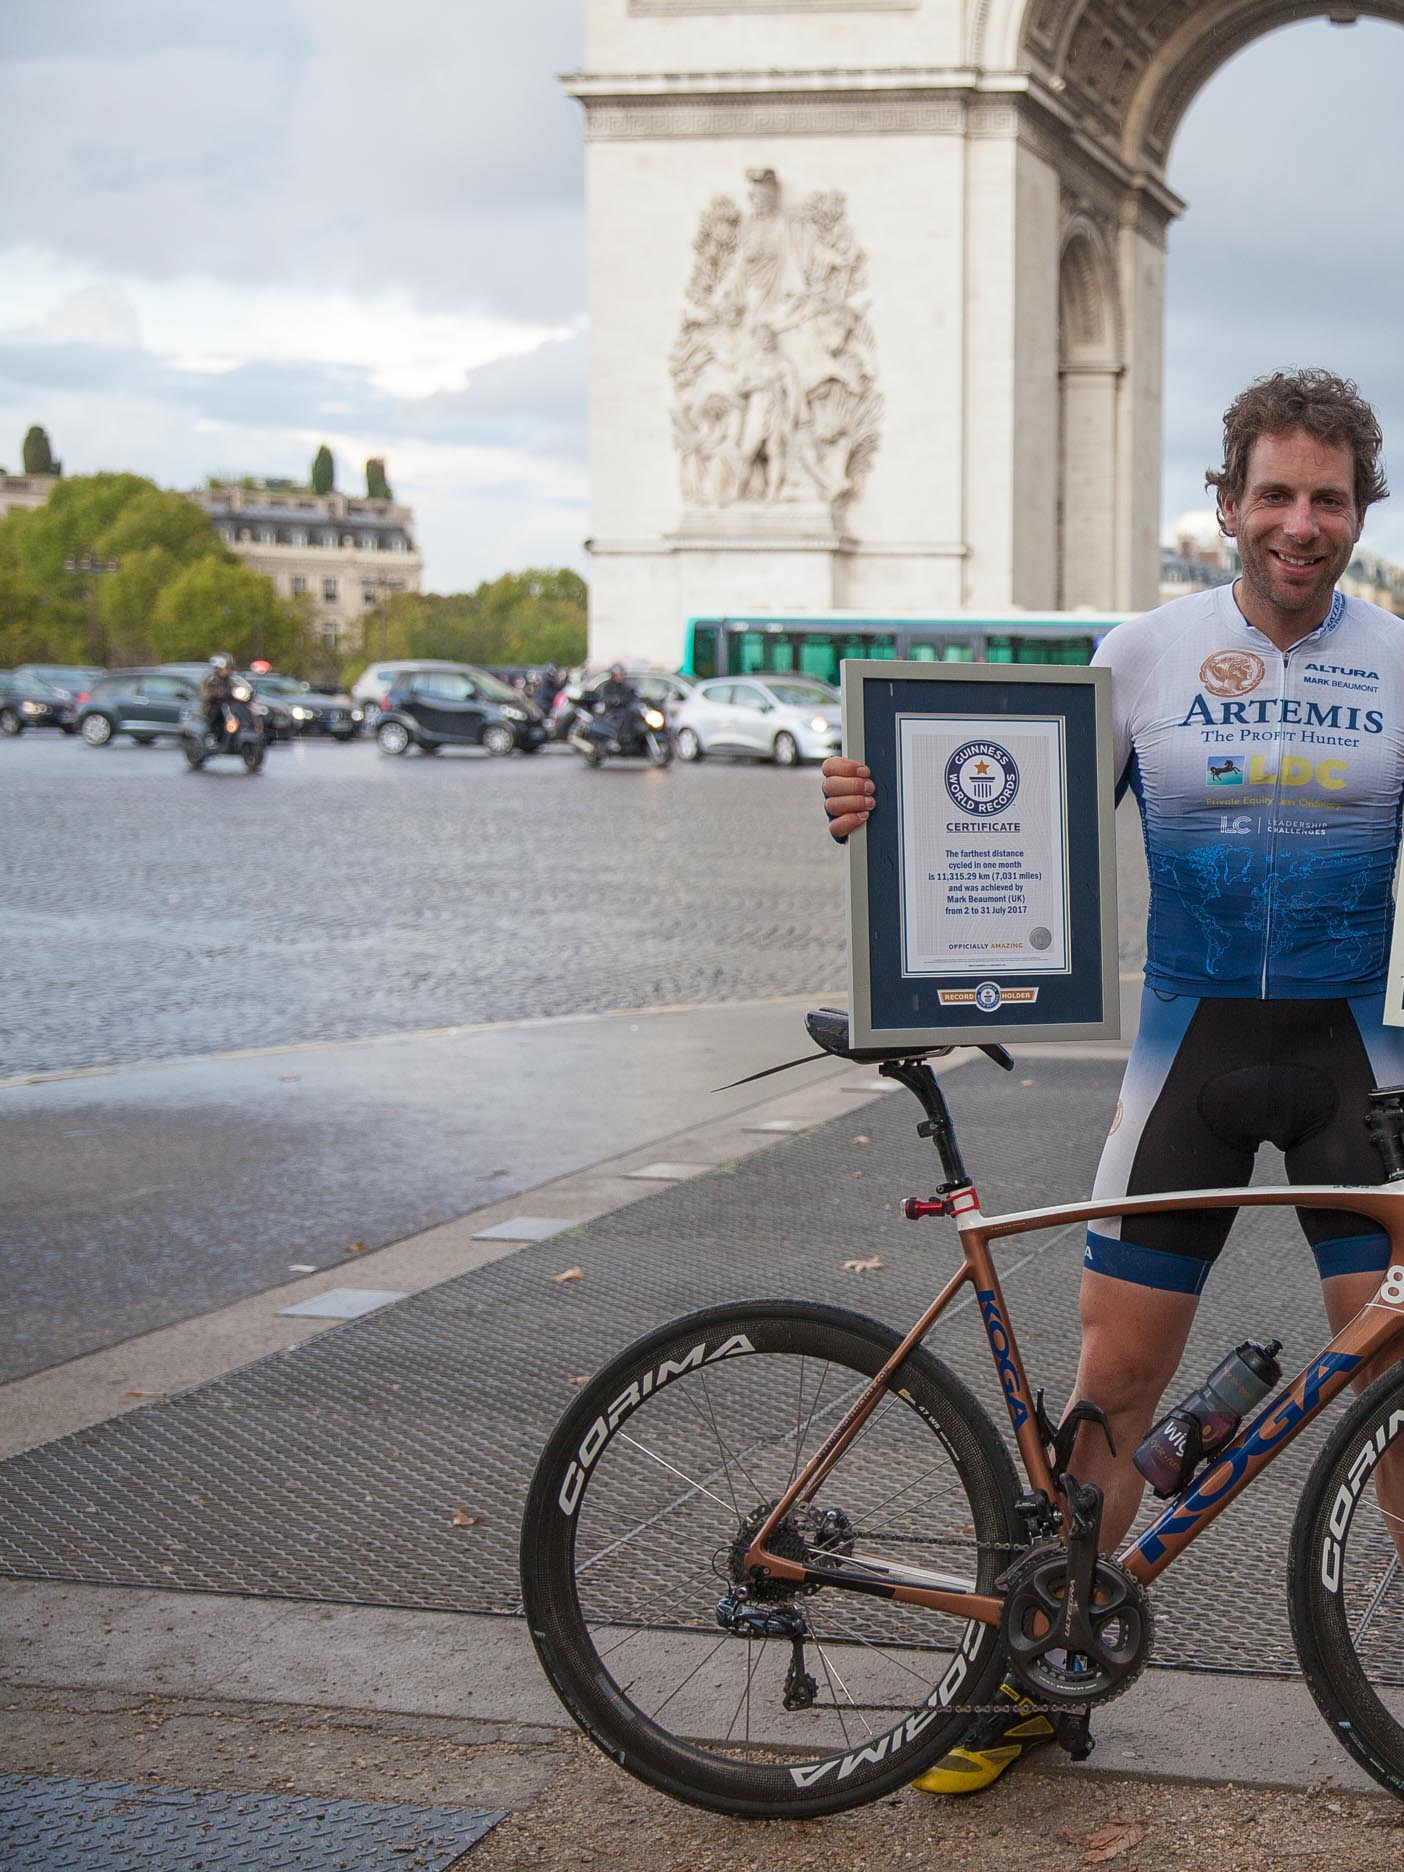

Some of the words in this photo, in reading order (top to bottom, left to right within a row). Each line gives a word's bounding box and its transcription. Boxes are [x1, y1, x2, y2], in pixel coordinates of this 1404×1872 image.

[1304, 663, 1380, 680] ALTURA
[1303, 676, 1330, 686] MARK
[1331, 680, 1379, 693] BEAUMONT
[1178, 693, 1384, 734] ARTEMIS
[1201, 730, 1234, 743] The
[1301, 731, 1360, 748] Hunter
[955, 745, 1009, 765] GUINNESS
[1248, 755, 1349, 790] LDC
[949, 773, 975, 810] WORLD
[978, 773, 1016, 813] RECORDS
[1206, 797, 1240, 806] Private
[946, 822, 1021, 832] CERTIFICATE
[1267, 818, 1328, 829] LEADERSHIP
[1267, 827, 1327, 836] CHALLENGES
[945, 850, 959, 858] The
[961, 850, 991, 858] farthest
[992, 850, 1024, 858] distance
[948, 861, 972, 870] cycled
[937, 873, 977, 882] 11,315.29
[992, 872, 1018, 881] (7,031
[1019, 872, 1042, 881] miles)
[948, 884, 962, 892] and
[980, 884, 1014, 892] achieved
[1015, 884, 1024, 893] by
[947, 895, 967, 903] Mark
[969, 895, 1006, 903] Beaumont
[1008, 895, 1026, 904] (UK)
[945, 907, 963, 915] from
[980, 906, 990, 914] 31
[992, 906, 1006, 915] July
[944, 993, 975, 1001] RECORD
[1001, 992, 1031, 1000] HOLDER
[977, 1289, 1028, 1431] KOGA
[558, 1333, 756, 1516] CORIMA
[1137, 1351, 1365, 1564] KOGA
[1064, 1579, 1076, 1638] ULTEGRA
